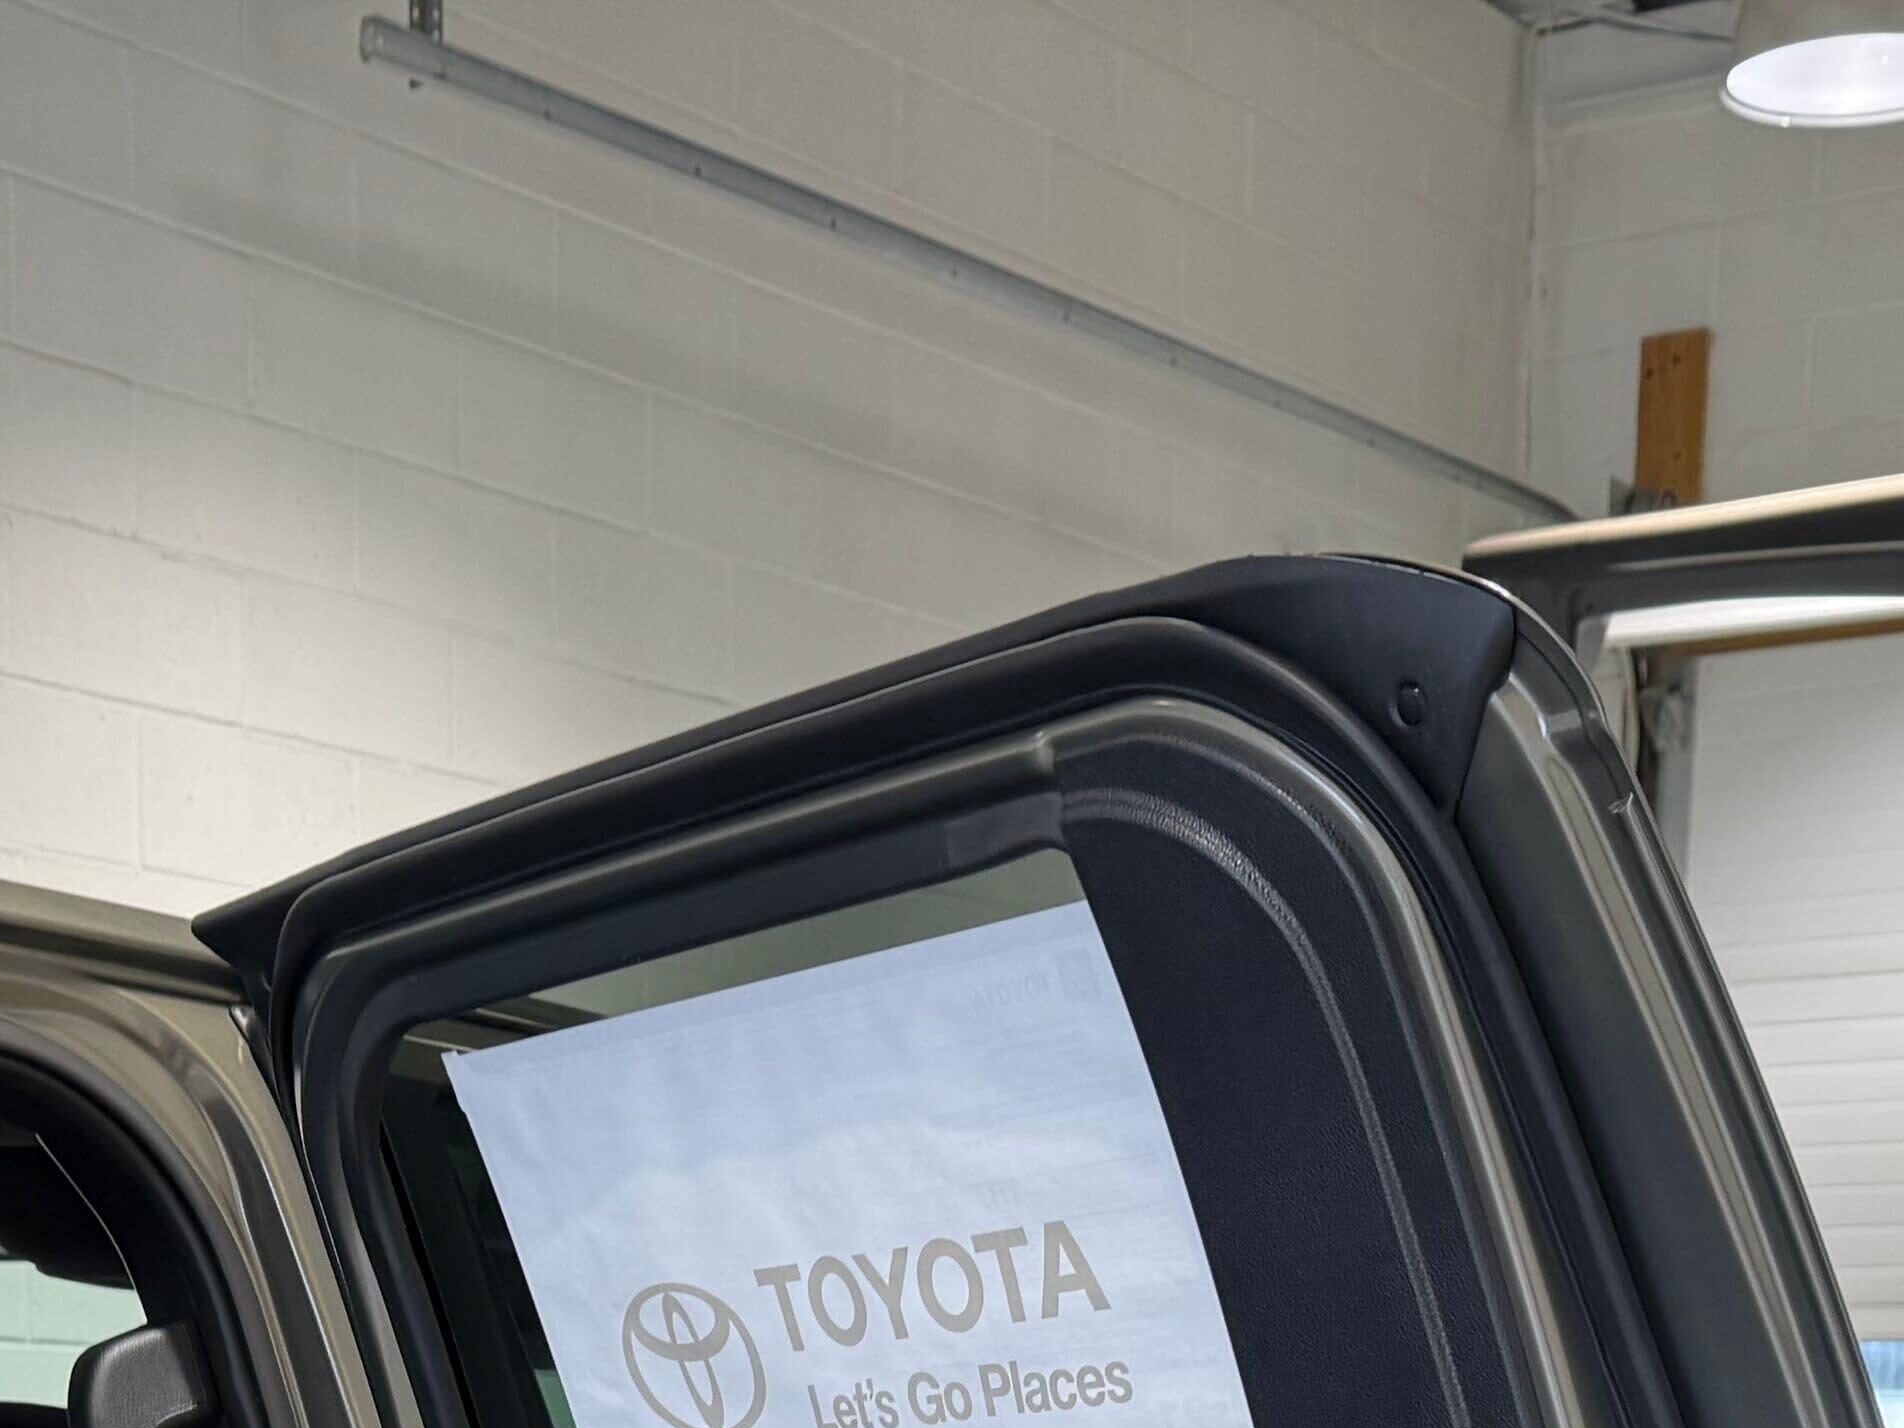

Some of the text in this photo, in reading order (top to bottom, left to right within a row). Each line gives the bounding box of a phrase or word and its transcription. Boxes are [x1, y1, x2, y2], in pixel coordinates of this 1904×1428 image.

[754, 1219, 1111, 1353] TOYOTA
[908, 1371, 974, 1426] Go
[980, 1358, 1133, 1418] Places
